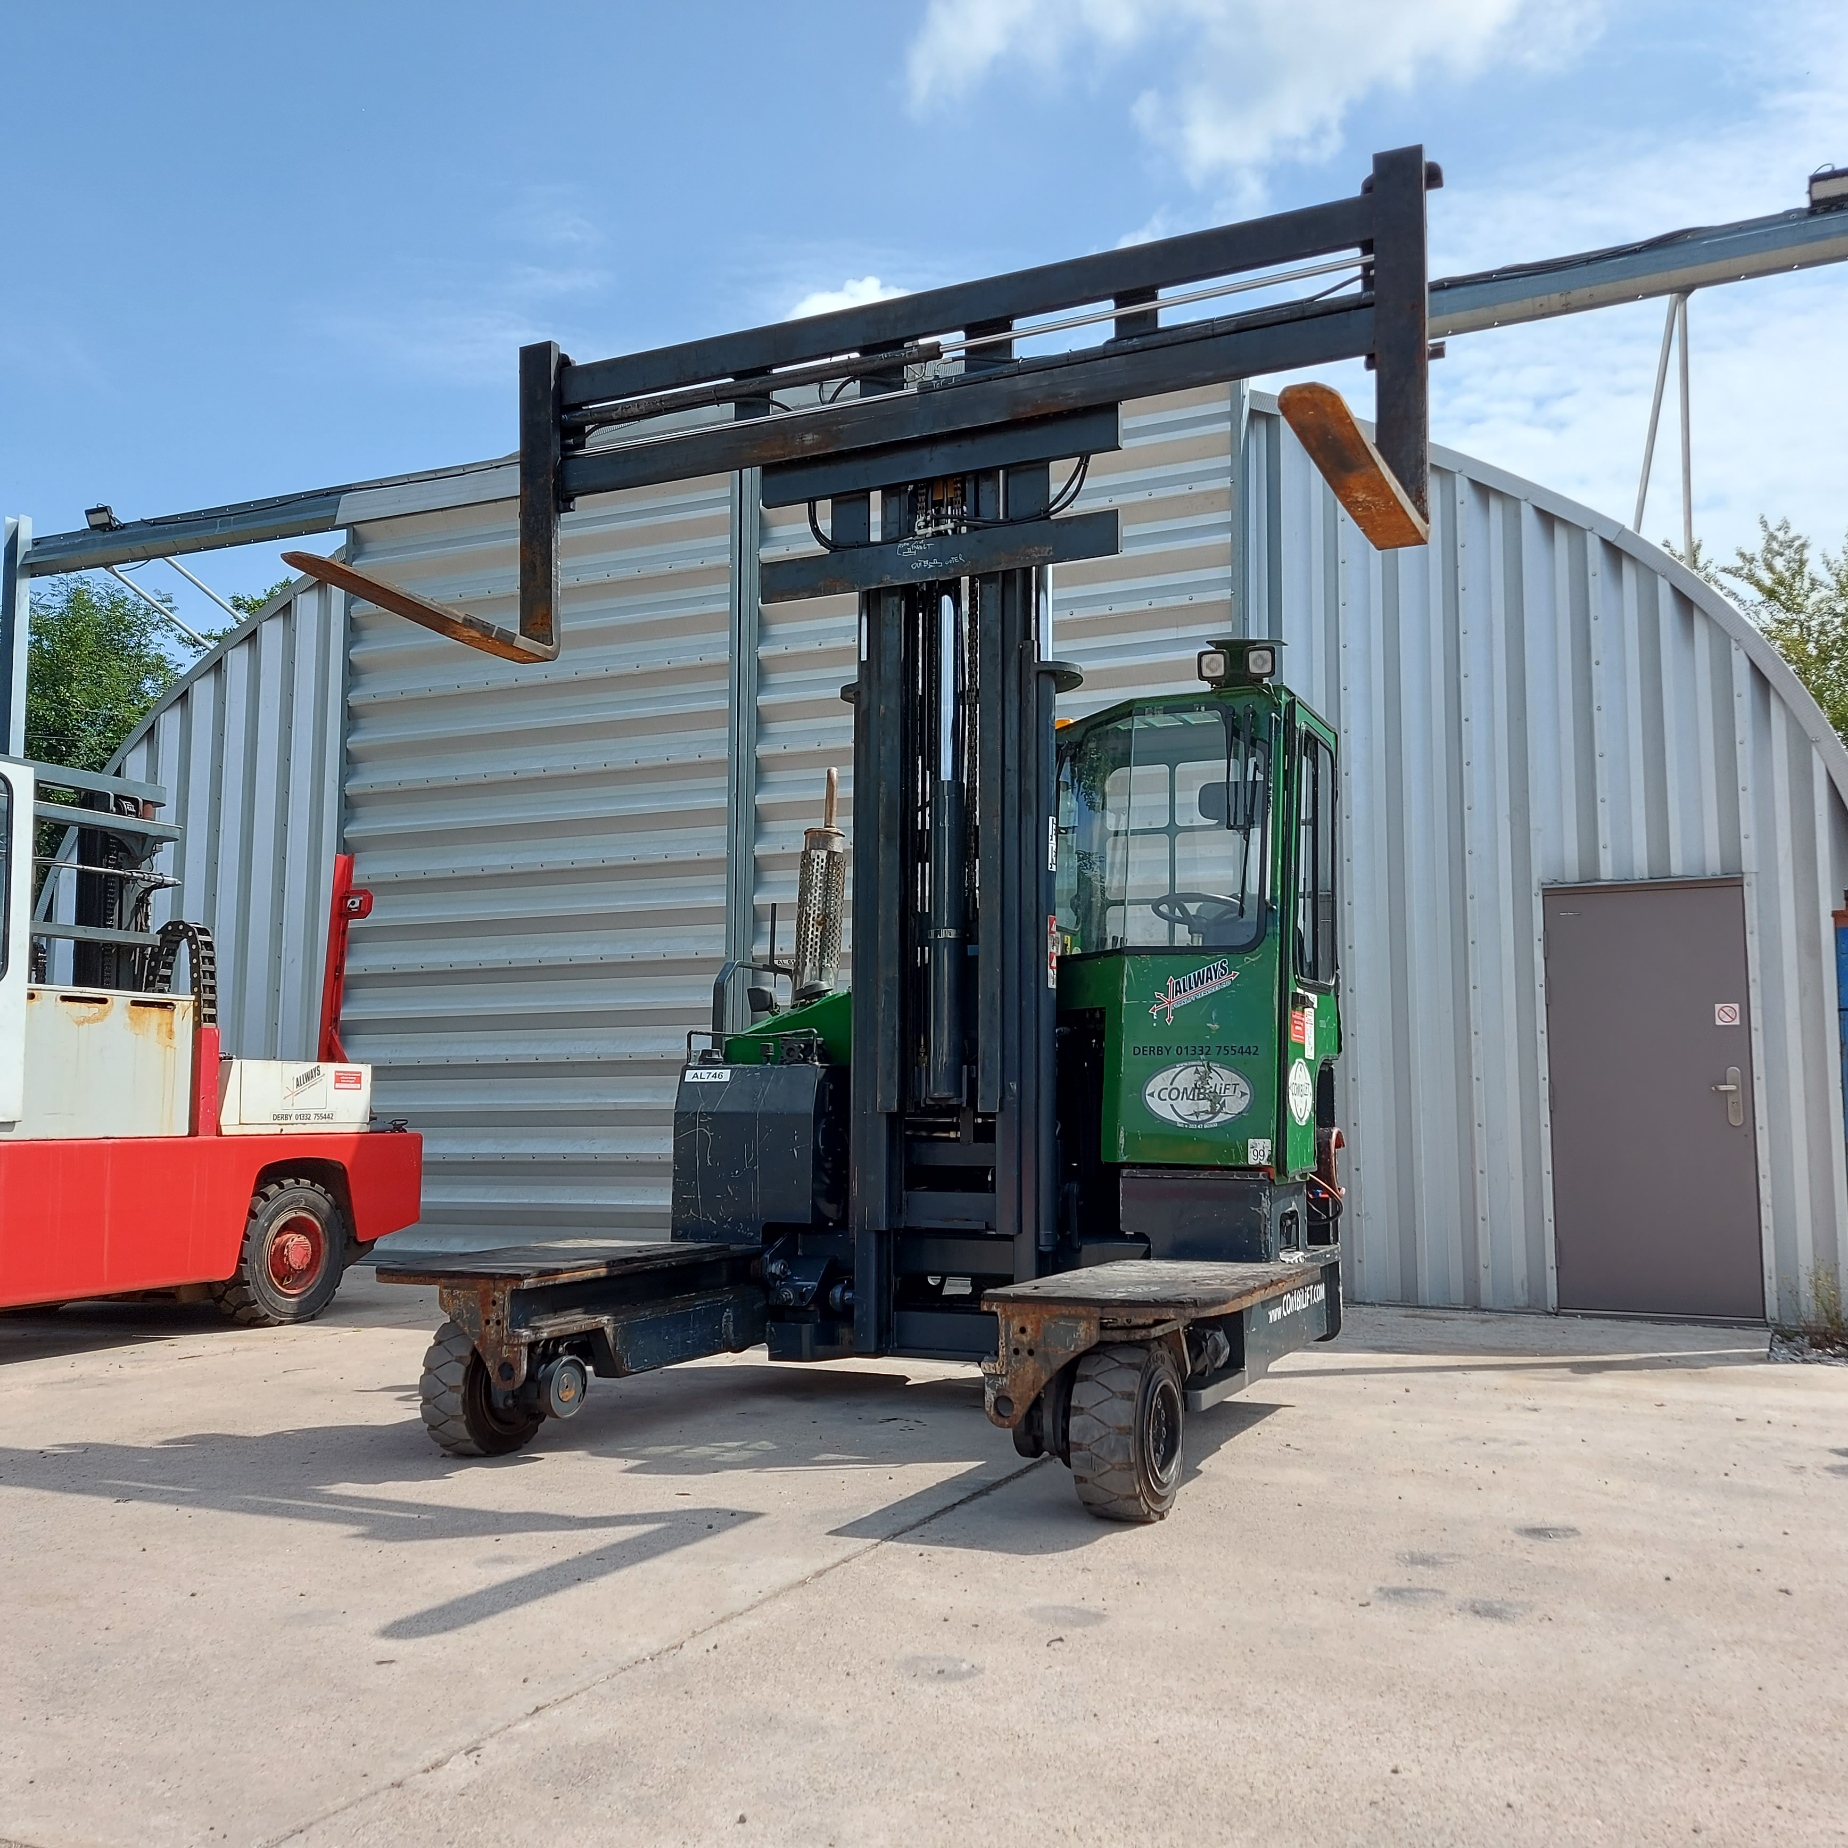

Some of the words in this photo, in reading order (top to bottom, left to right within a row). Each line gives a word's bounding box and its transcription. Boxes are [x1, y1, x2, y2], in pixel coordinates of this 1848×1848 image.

[1174, 959, 1228, 997] ALLWAYS
[1133, 1046, 1172, 1056] DERBY
[1175, 1045, 1212, 1056] 01332
[1216, 1045, 1260, 1056] 755442
[295, 1065, 321, 1089] ALLWAYS
[691, 1071, 724, 1080] AL746
[272, 1113, 293, 1121] DERBY
[295, 1113, 311, 1121] 01332
[313, 1112, 334, 1121] 755442
[1252, 1148, 1265, 1161] 99
